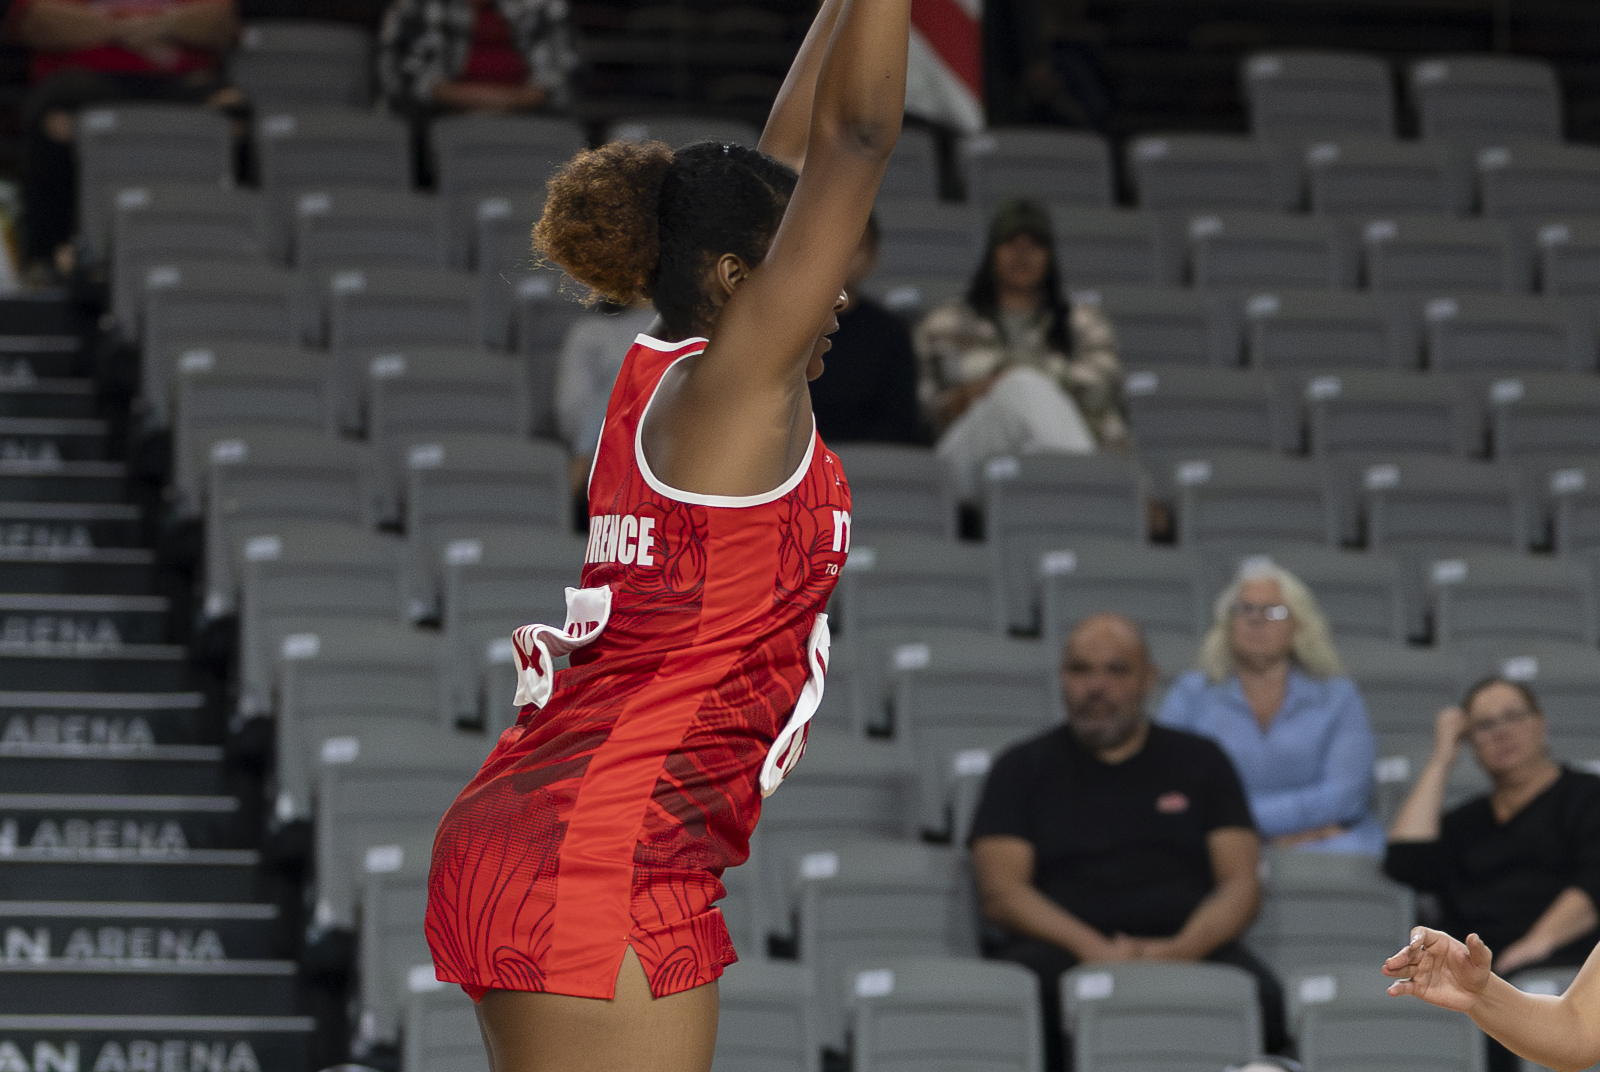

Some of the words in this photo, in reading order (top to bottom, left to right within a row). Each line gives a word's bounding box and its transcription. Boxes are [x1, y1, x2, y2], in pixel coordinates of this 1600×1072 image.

[585, 514, 655, 566] RENCE
[30, 817, 188, 858] ARENA
[62, 926, 226, 966] ARENA
